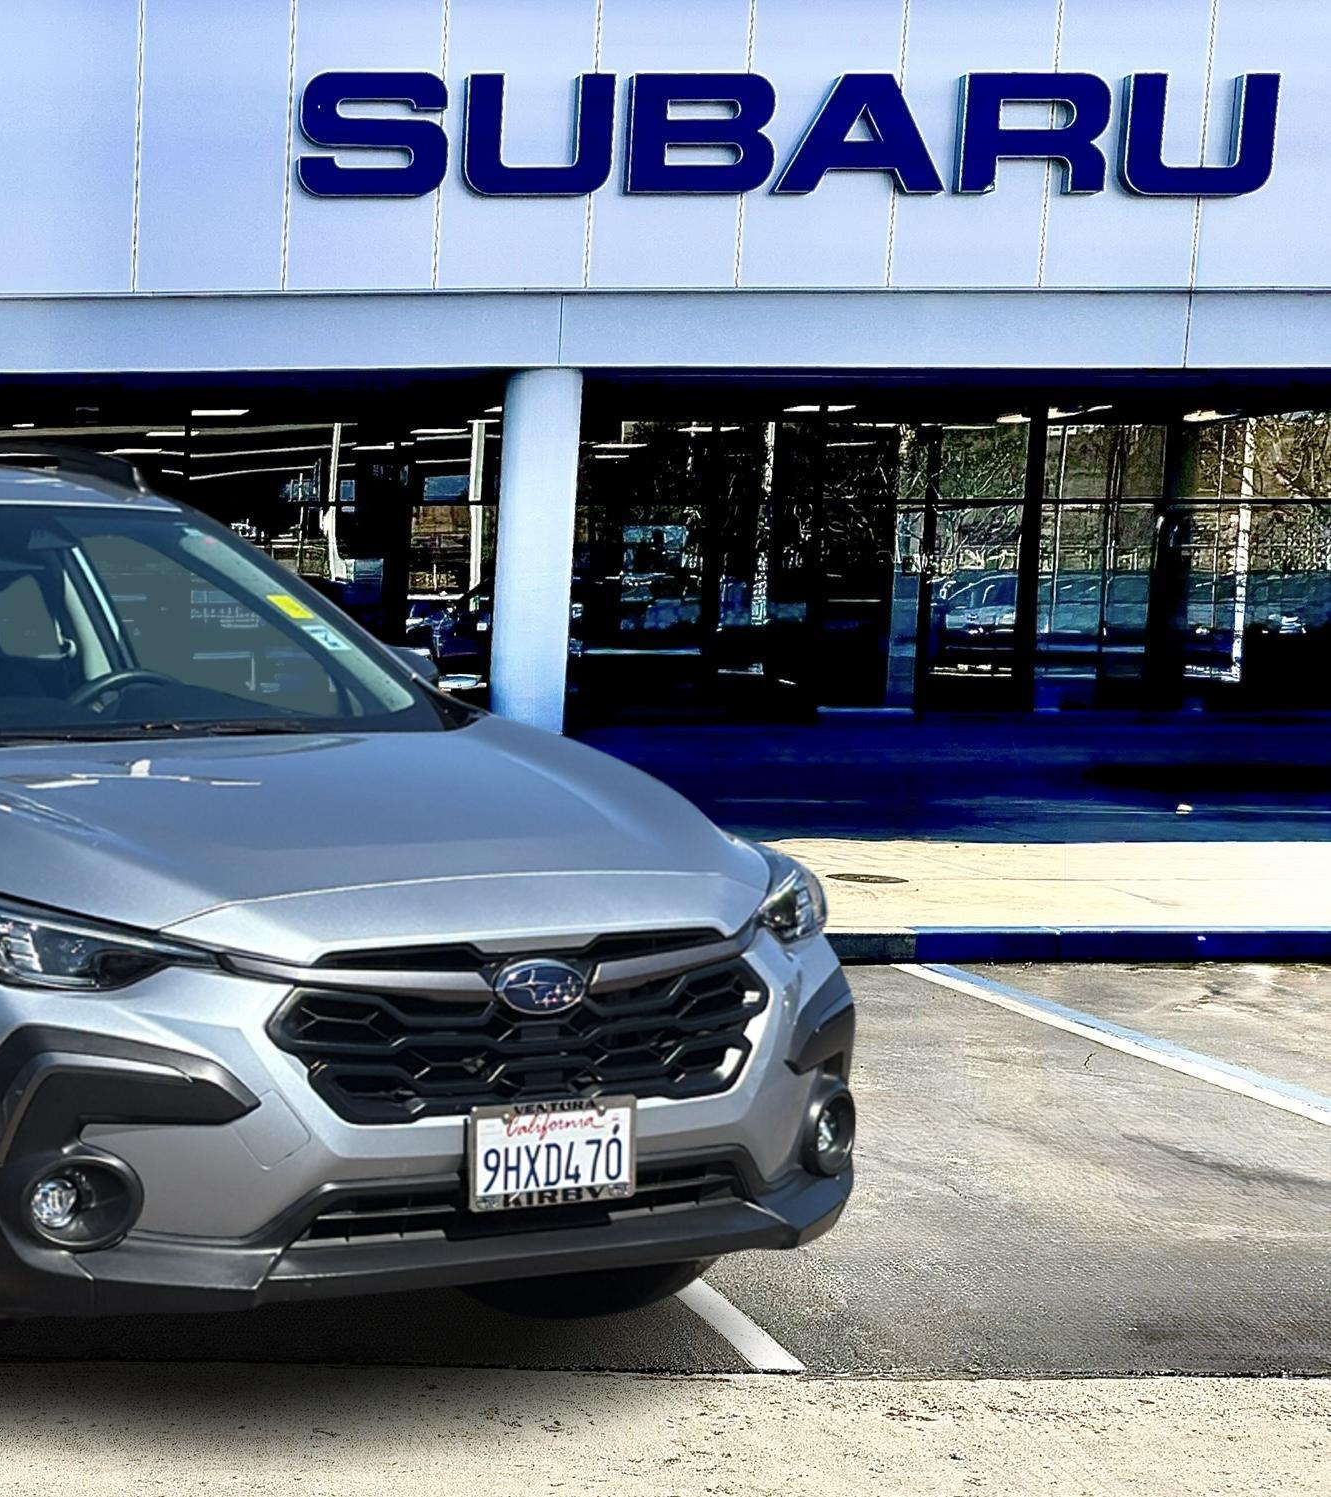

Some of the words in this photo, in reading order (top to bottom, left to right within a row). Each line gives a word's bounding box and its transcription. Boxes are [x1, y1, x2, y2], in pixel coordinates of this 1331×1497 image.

[297, 71, 1283, 198] SUBARU
[513, 1099, 598, 1115] VENTURA
[506, 1111, 605, 1140] California
[483, 1137, 622, 1193] 9HXD470
[502, 1186, 604, 1208] KIRBY
